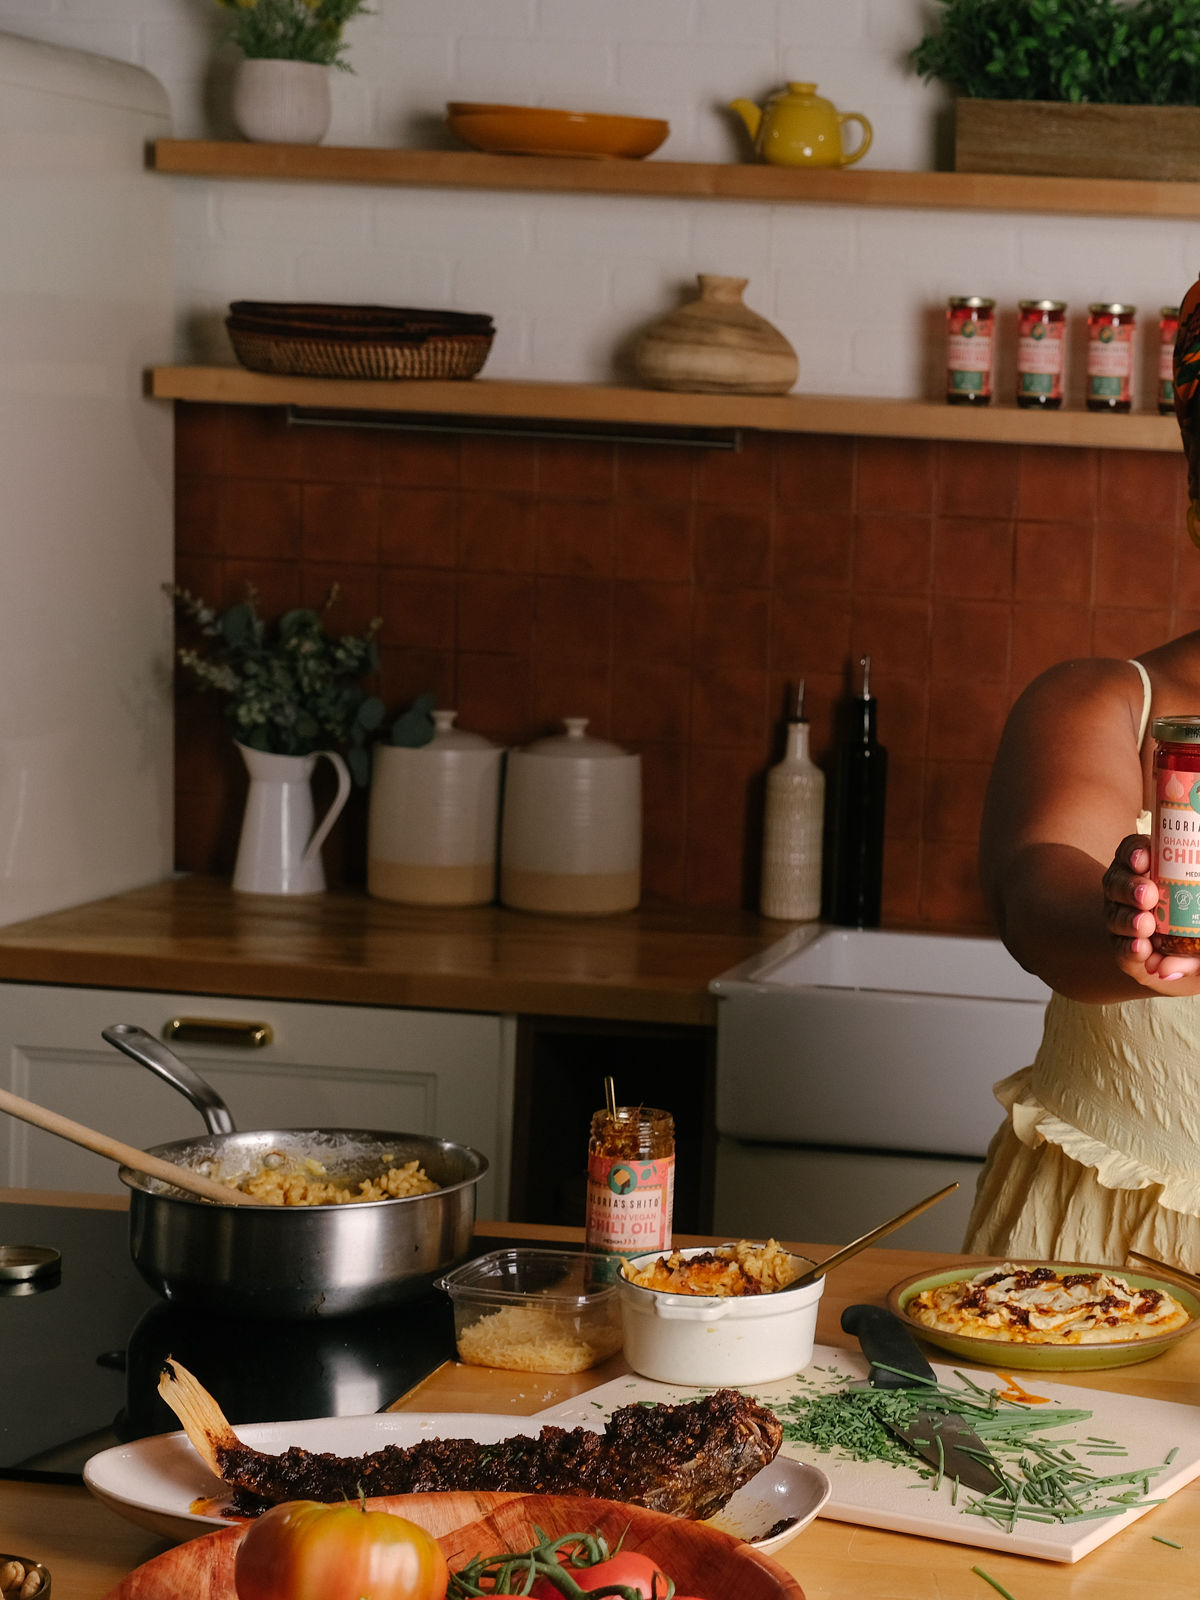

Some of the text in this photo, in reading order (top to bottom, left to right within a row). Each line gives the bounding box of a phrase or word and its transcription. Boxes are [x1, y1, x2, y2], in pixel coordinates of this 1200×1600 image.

[629, 1198, 659, 1209] SHITO
[628, 1212, 657, 1221] VEGAN
[631, 1221, 657, 1235] OIL
